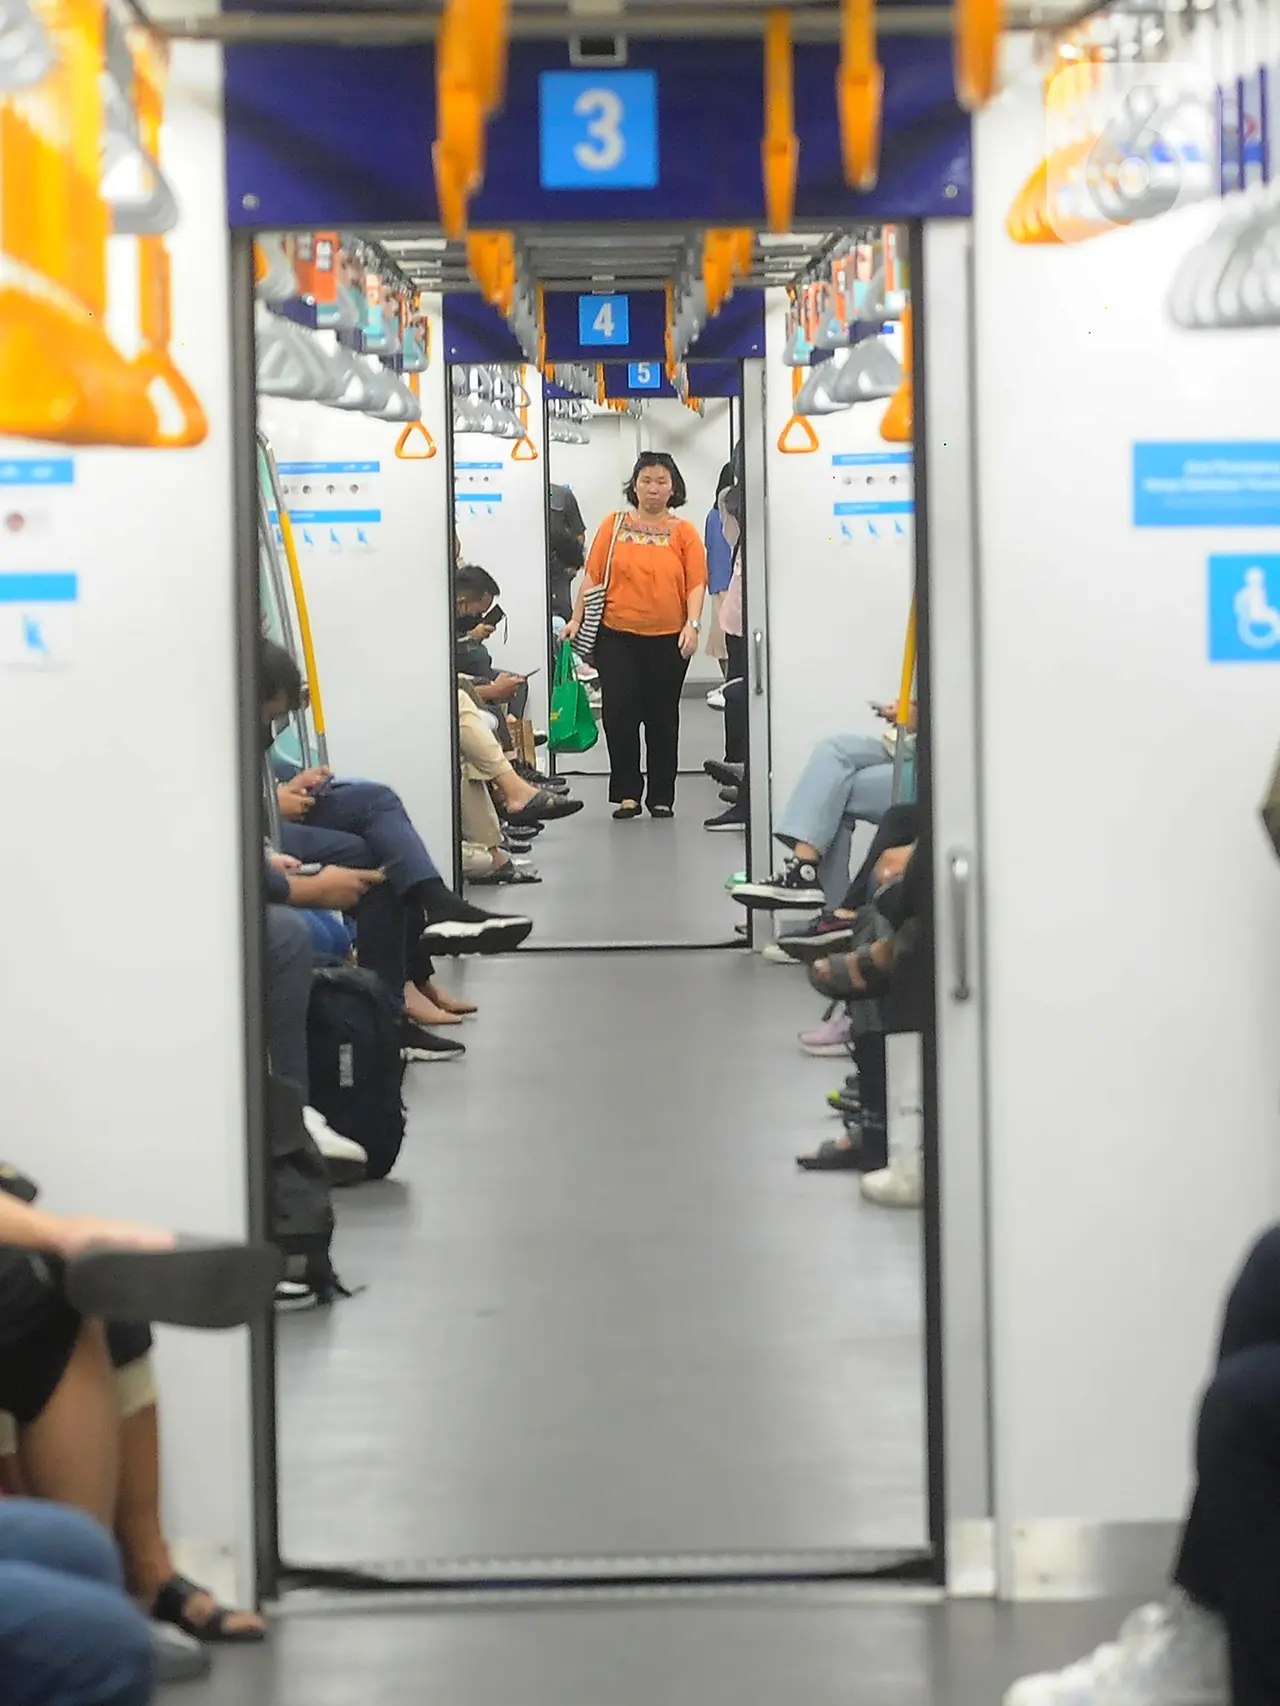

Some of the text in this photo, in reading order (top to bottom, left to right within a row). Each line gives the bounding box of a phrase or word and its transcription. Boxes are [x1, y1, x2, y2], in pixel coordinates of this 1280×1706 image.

[574, 88, 625, 171] 3
[593, 302, 614, 337] 4
[638, 361, 650, 383] 5
